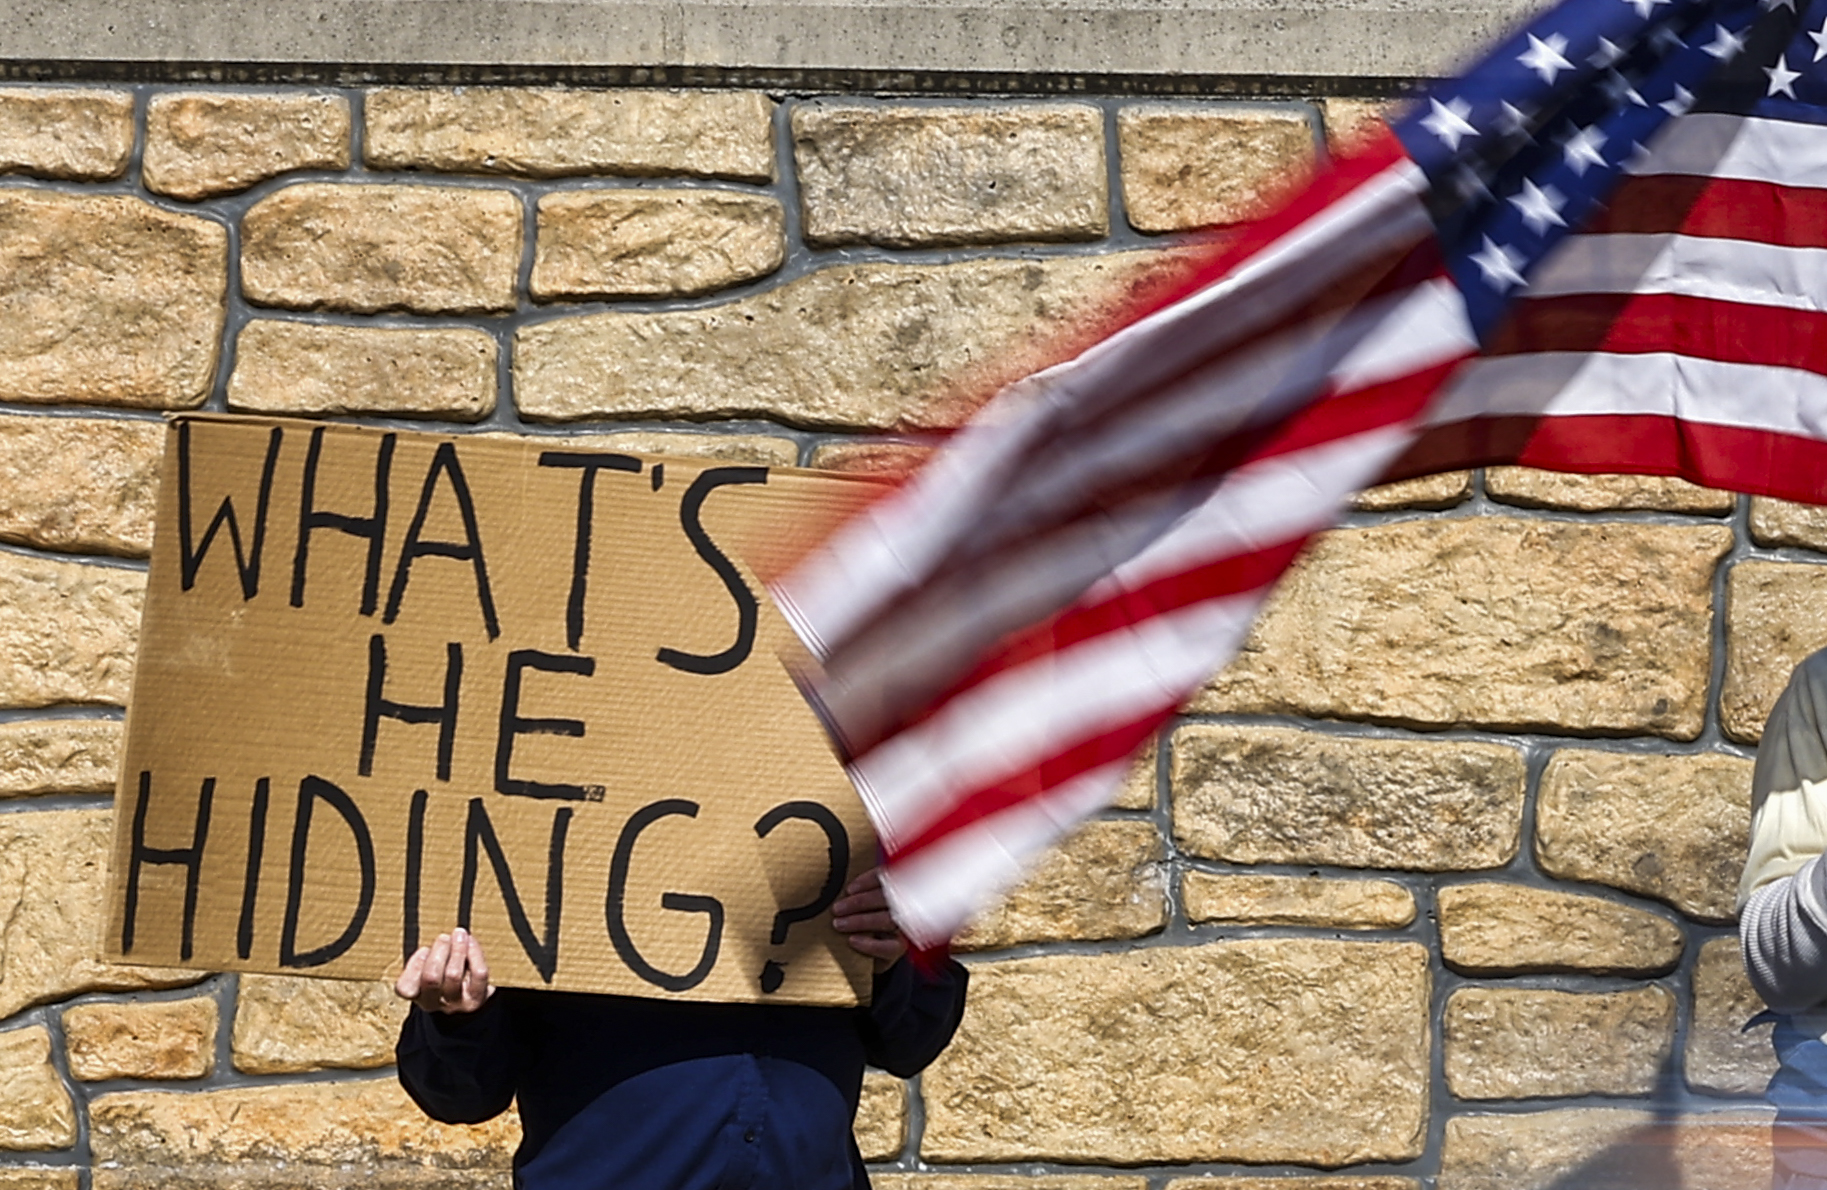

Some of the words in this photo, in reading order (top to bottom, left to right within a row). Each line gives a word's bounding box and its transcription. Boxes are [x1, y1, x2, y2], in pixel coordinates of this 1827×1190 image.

[178, 421, 770, 676] WHAT'S
[359, 634, 605, 802] HE
[122, 770, 850, 993] HIDING?
